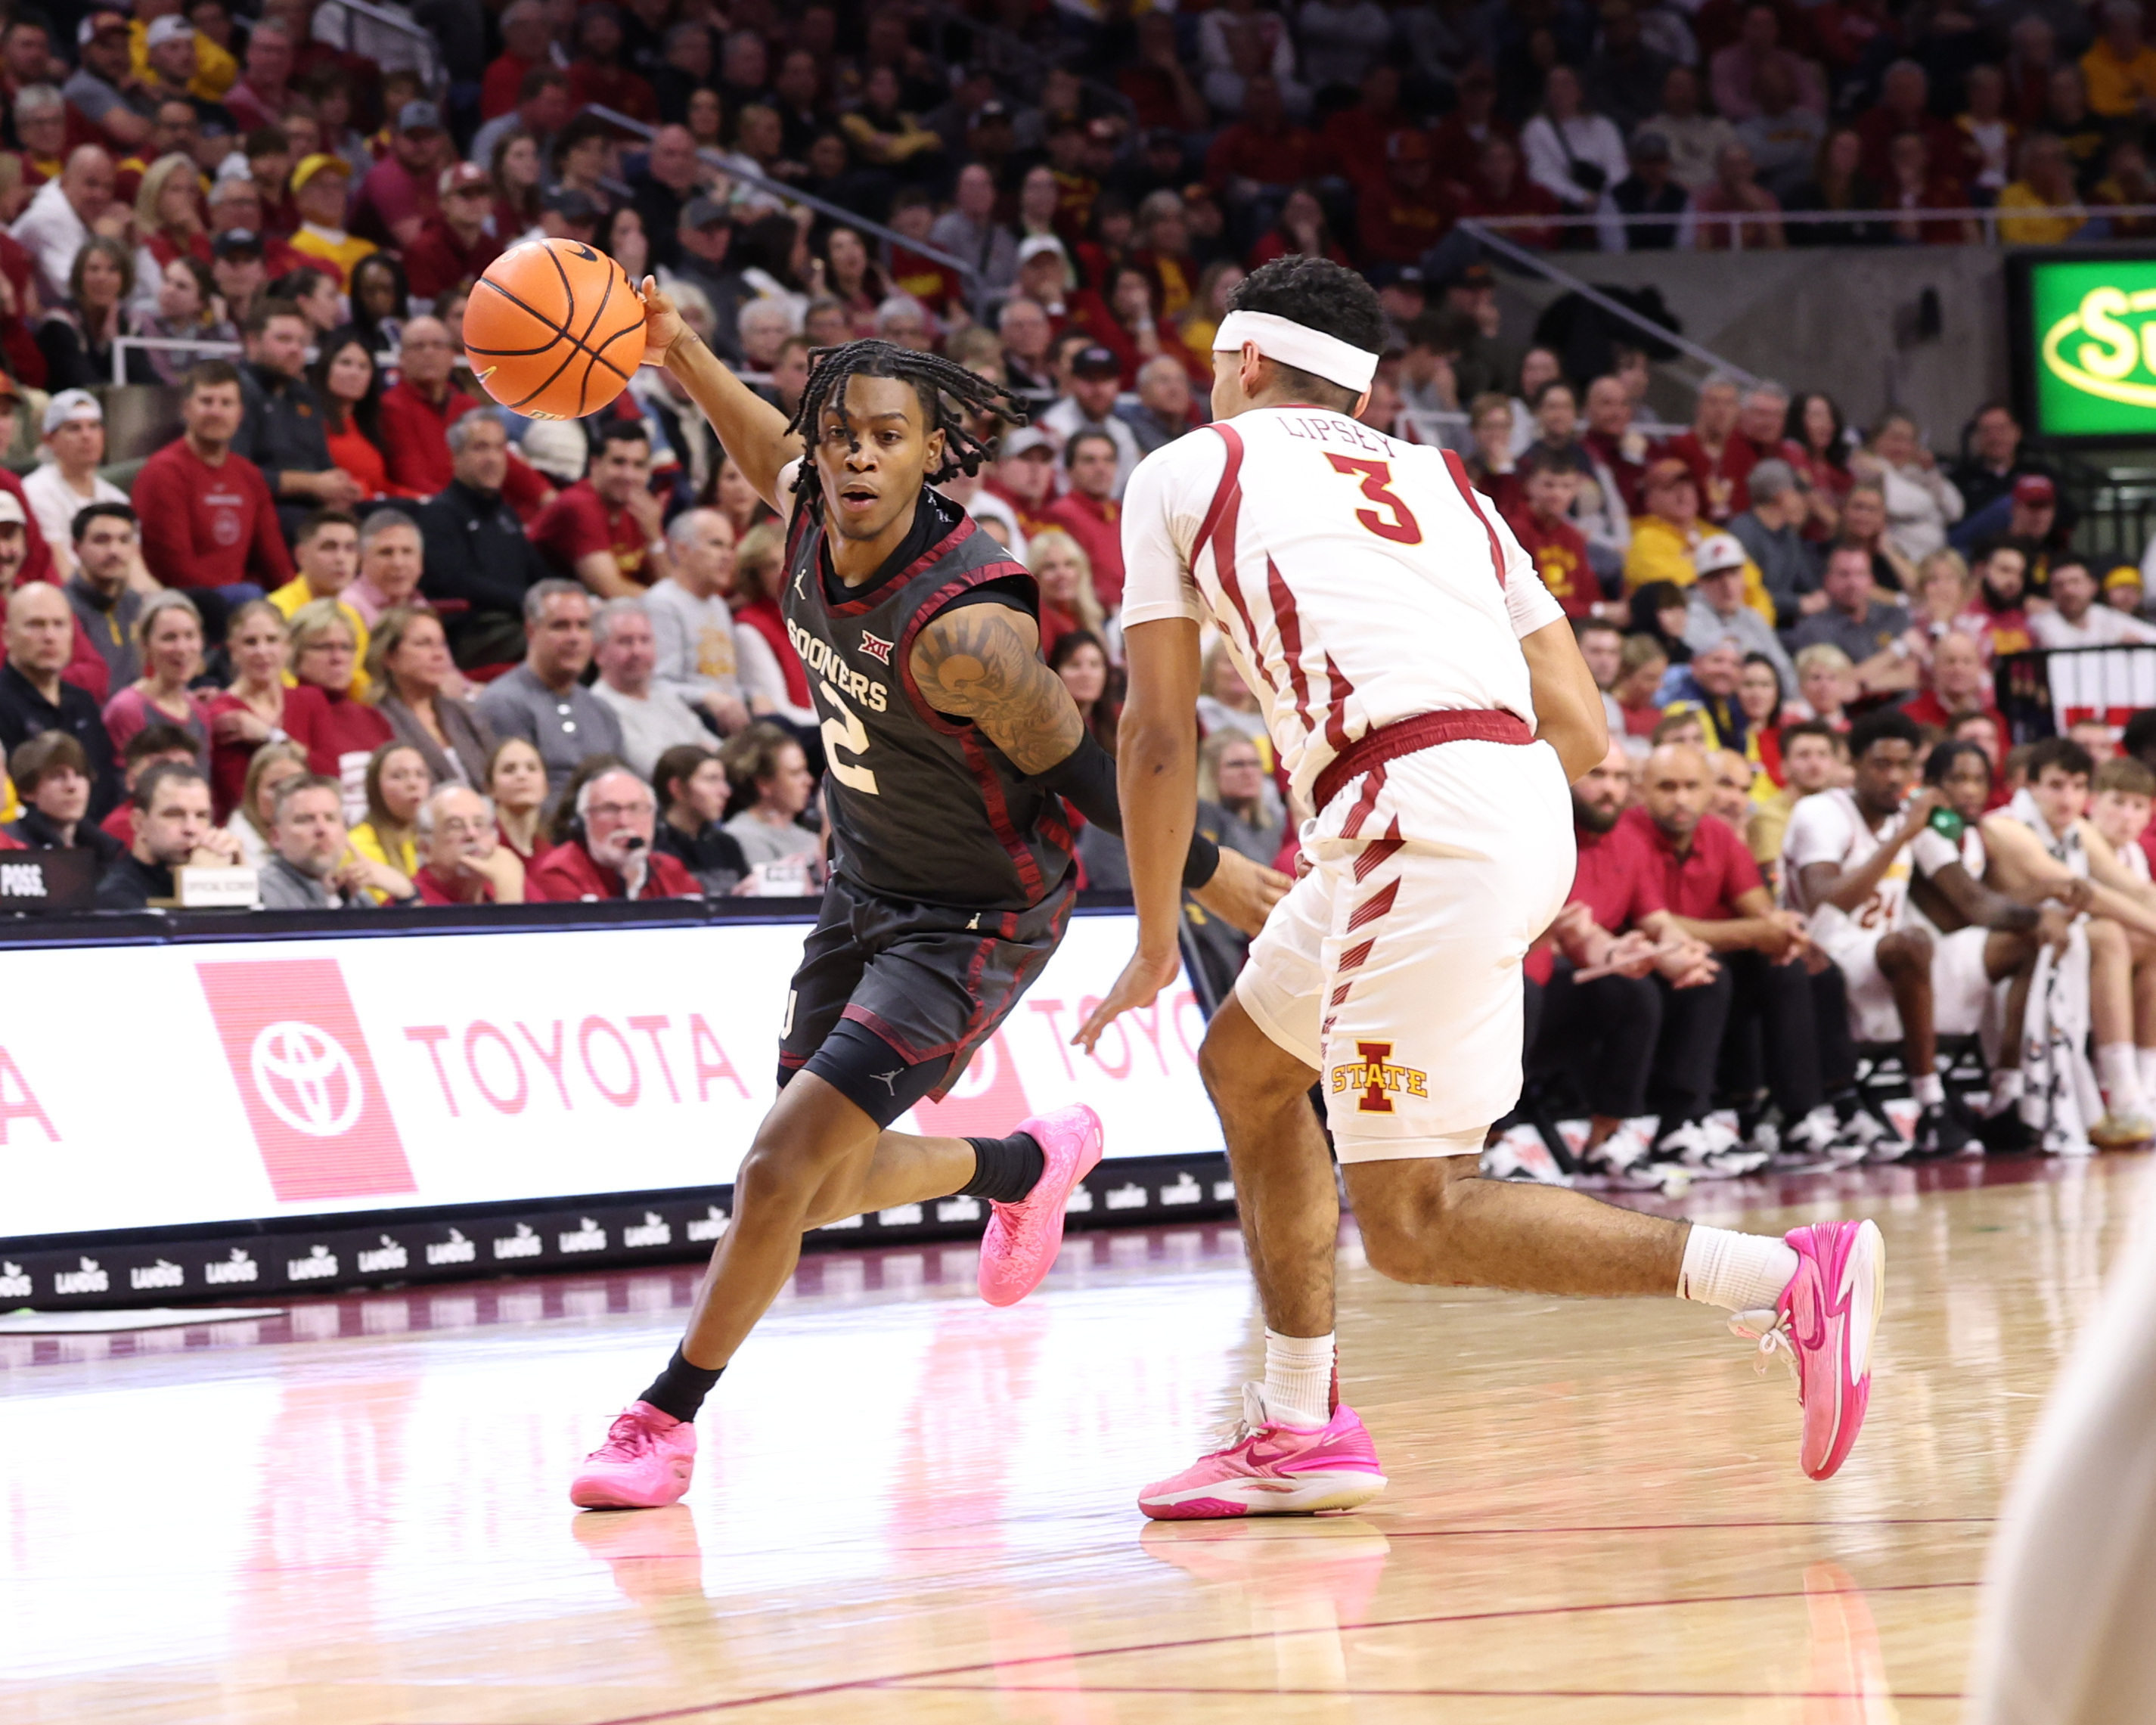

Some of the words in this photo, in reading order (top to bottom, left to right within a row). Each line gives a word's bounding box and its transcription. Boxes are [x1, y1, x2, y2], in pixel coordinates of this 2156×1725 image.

[1276, 417, 1396, 458] LIPSEY
[1321, 451, 1423, 546] 3
[787, 618, 888, 712] SOONERS
[819, 681, 879, 795] 2
[402, 1013, 752, 1117] TOYOTA
[1332, 1063, 1429, 1098] STATE
